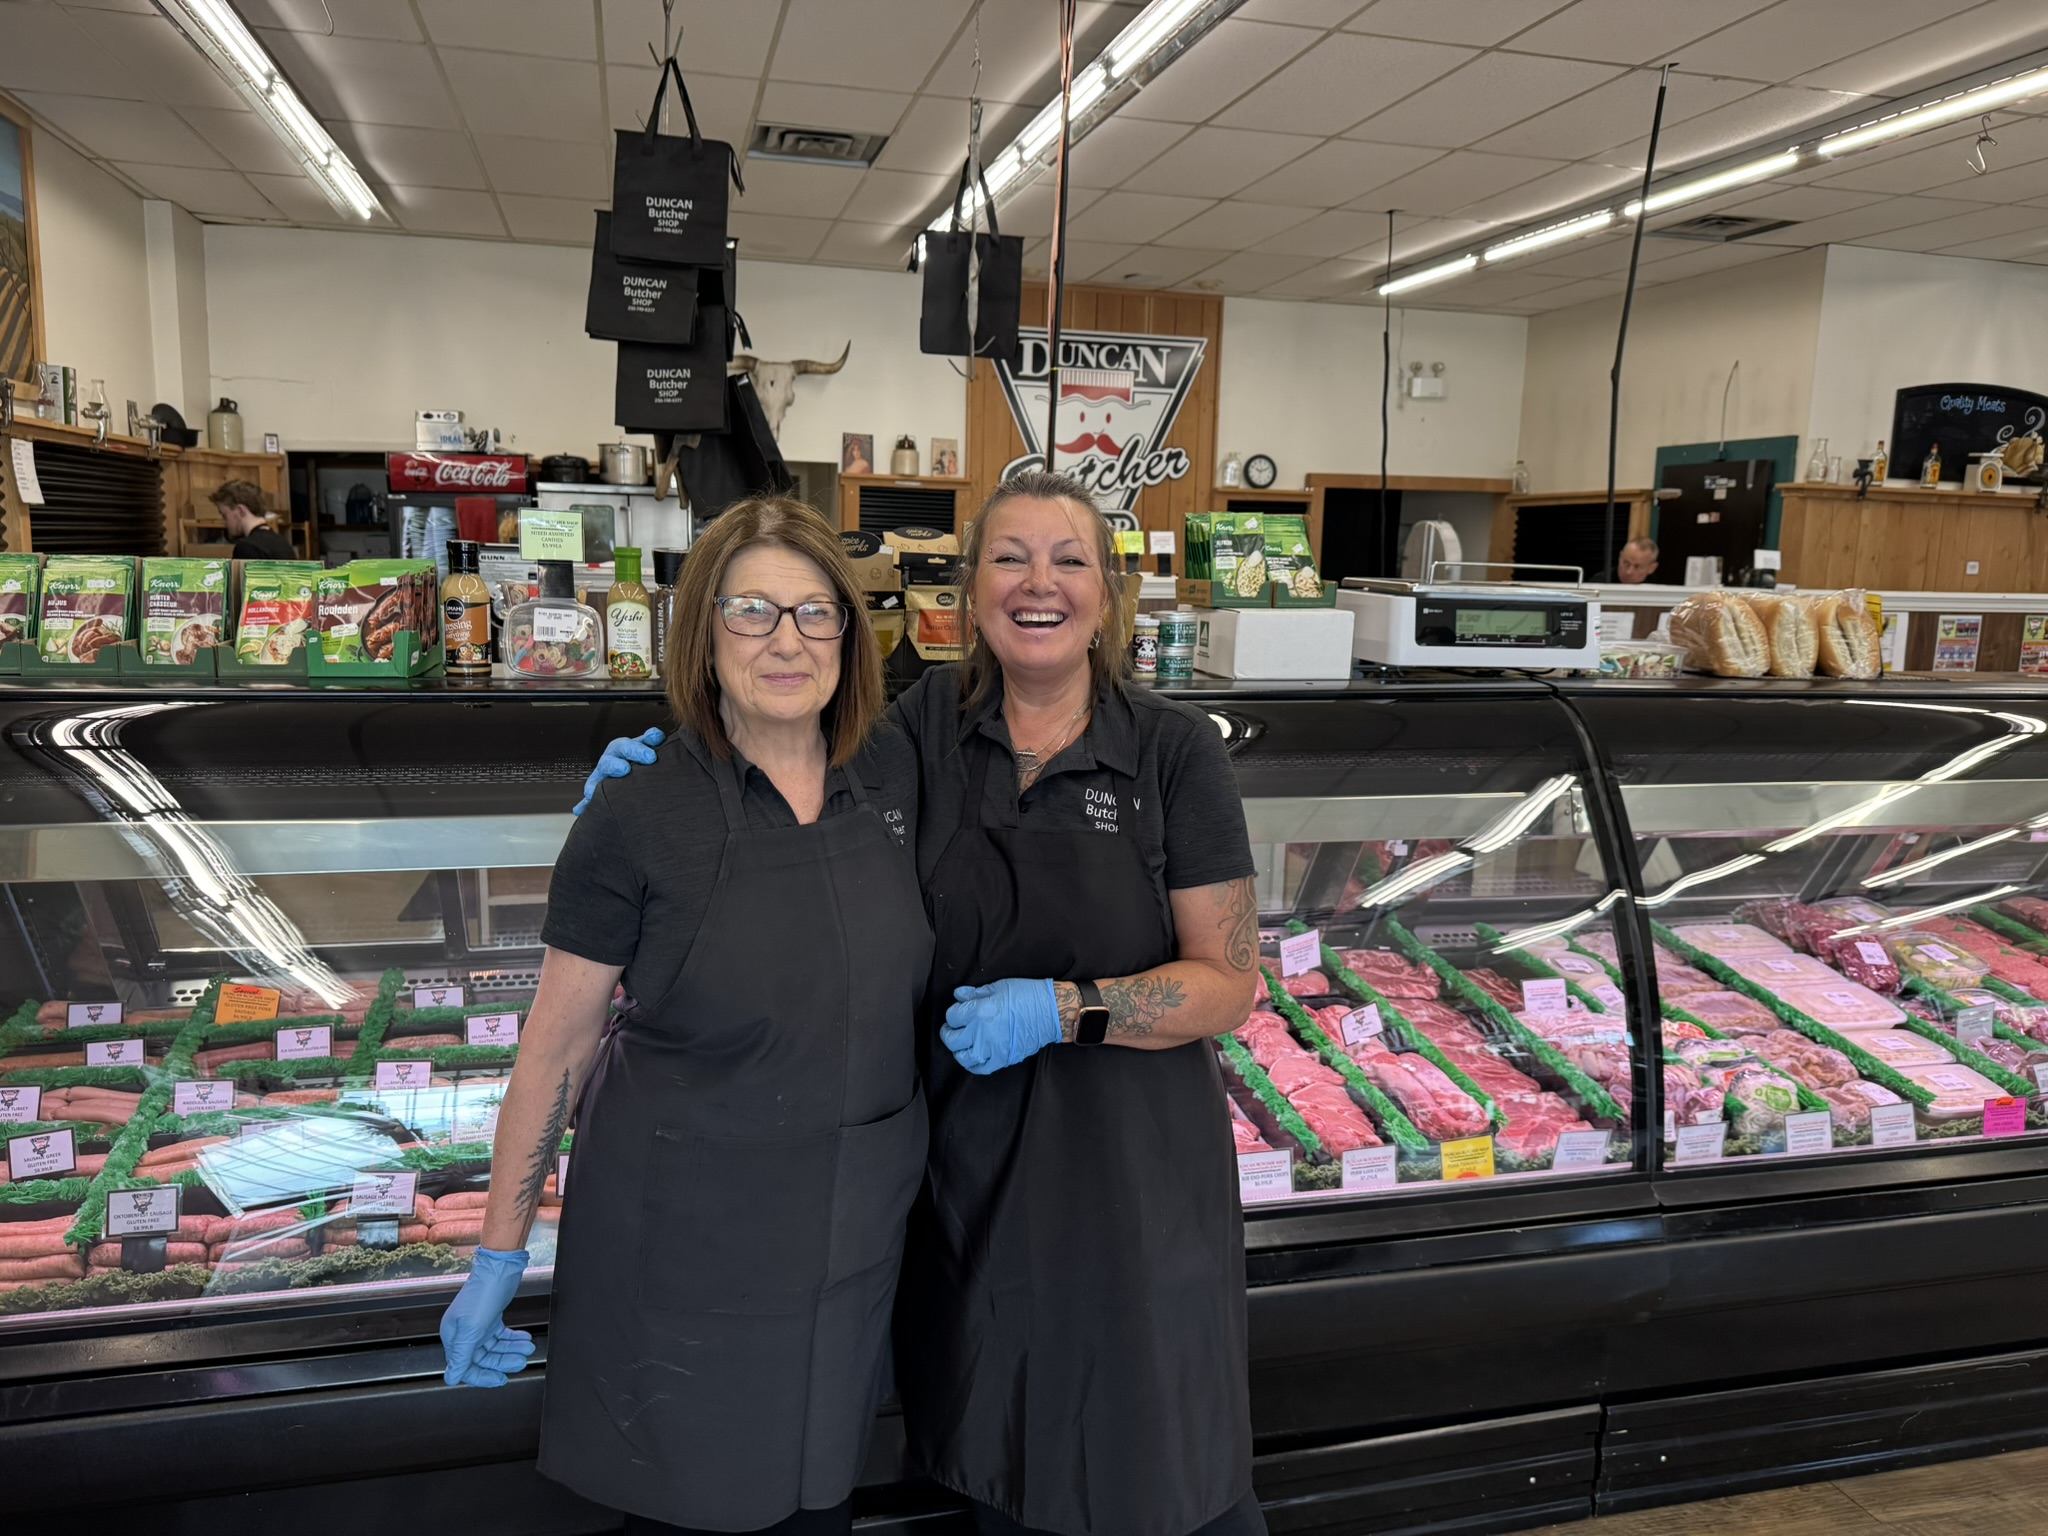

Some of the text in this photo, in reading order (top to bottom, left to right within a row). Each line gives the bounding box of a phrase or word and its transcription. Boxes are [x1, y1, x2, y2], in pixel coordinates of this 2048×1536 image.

[645, 196, 693, 210] DUNCAN
[648, 207, 689, 220] Butcher
[658, 218, 679, 227] SHOP
[623, 276, 667, 289] DUNCAN
[623, 286, 662, 299] Butcher
[632, 298, 652, 306] SHOP
[1018, 338, 1171, 385] DUNCAN
[646, 368, 691, 378] DUNCAN
[649, 379, 688, 390] Butcher
[658, 389, 679, 398] SHOP
[1940, 394, 2007, 415] Quality Meats
[440, 435, 462, 444] IDEAL
[435, 460, 513, 487] Coca-Cola
[49, 581, 81, 590] Knorr
[150, 579, 180, 588] Knorr
[318, 580, 347, 590] Knorr
[318, 603, 358, 616] Rouladen
[610, 607, 644, 627] Yeshi
[445, 620, 473, 631] ressing
[1085, 803, 1117, 821] Butc
[113, 1209, 173, 1220] OKTOBERFEST SAUSAGE
